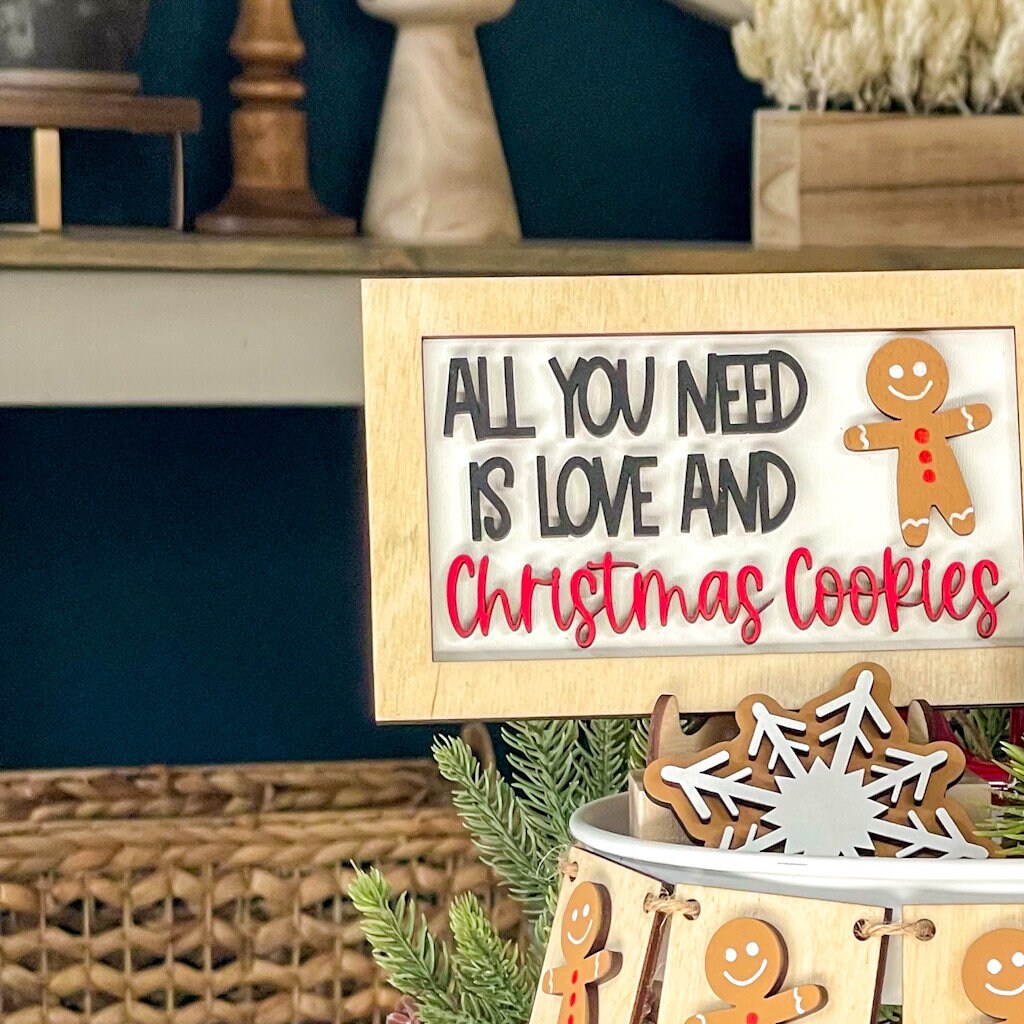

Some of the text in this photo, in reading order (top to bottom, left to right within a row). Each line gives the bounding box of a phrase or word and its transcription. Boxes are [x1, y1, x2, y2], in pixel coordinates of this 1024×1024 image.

[444, 349, 808, 441] ALL YOU NEED
[469, 450, 796, 541] IS LOVE AND
[447, 546, 1009, 648] Christmas Cookies
